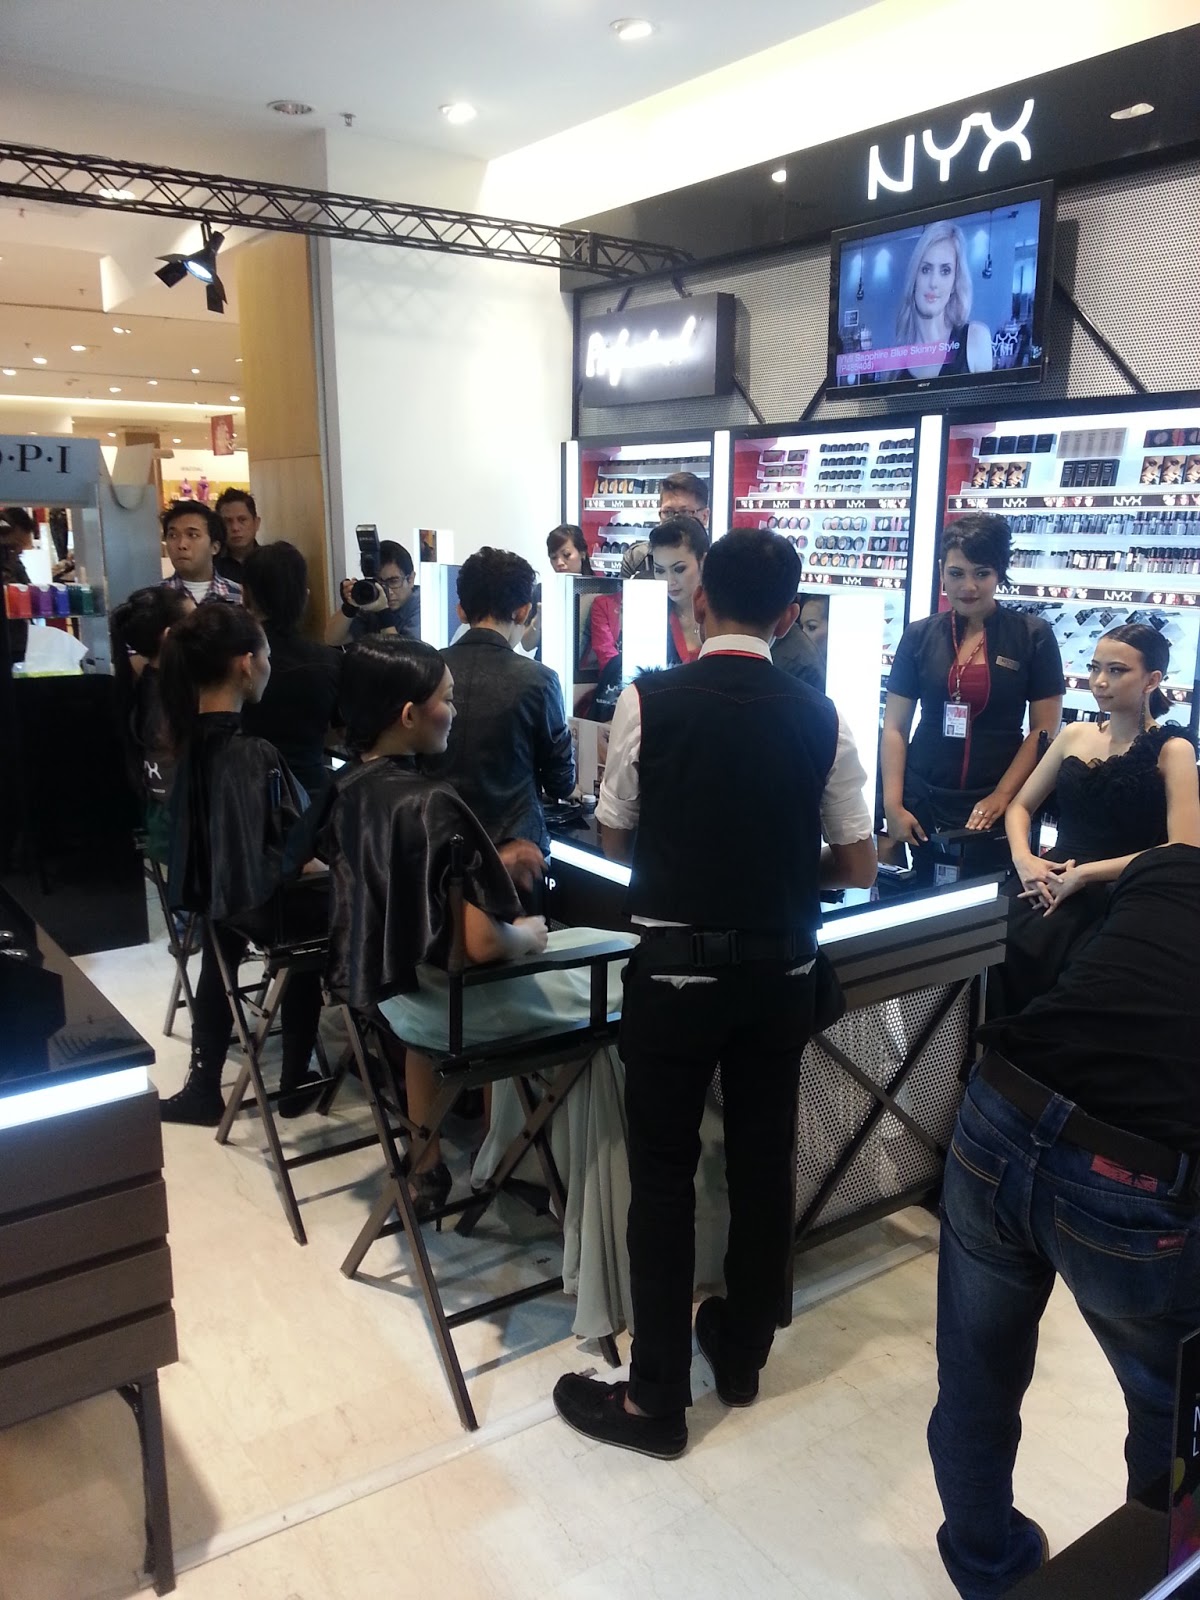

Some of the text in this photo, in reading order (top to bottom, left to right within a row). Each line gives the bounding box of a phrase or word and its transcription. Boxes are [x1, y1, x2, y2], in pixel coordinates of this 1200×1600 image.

[867, 98, 1035, 200] NYX
[855, 350, 889, 363] Sapphire
[890, 347, 908, 358] Blue
[910, 343, 937, 354] Skinny
[938, 340, 960, 353] Style
[772, 499, 865, 508] NYX NYX
[1002, 496, 1142, 508] NYX NYX
[842, 576, 862, 585] NYX
[995, 584, 1133, 601] NYX NYX
